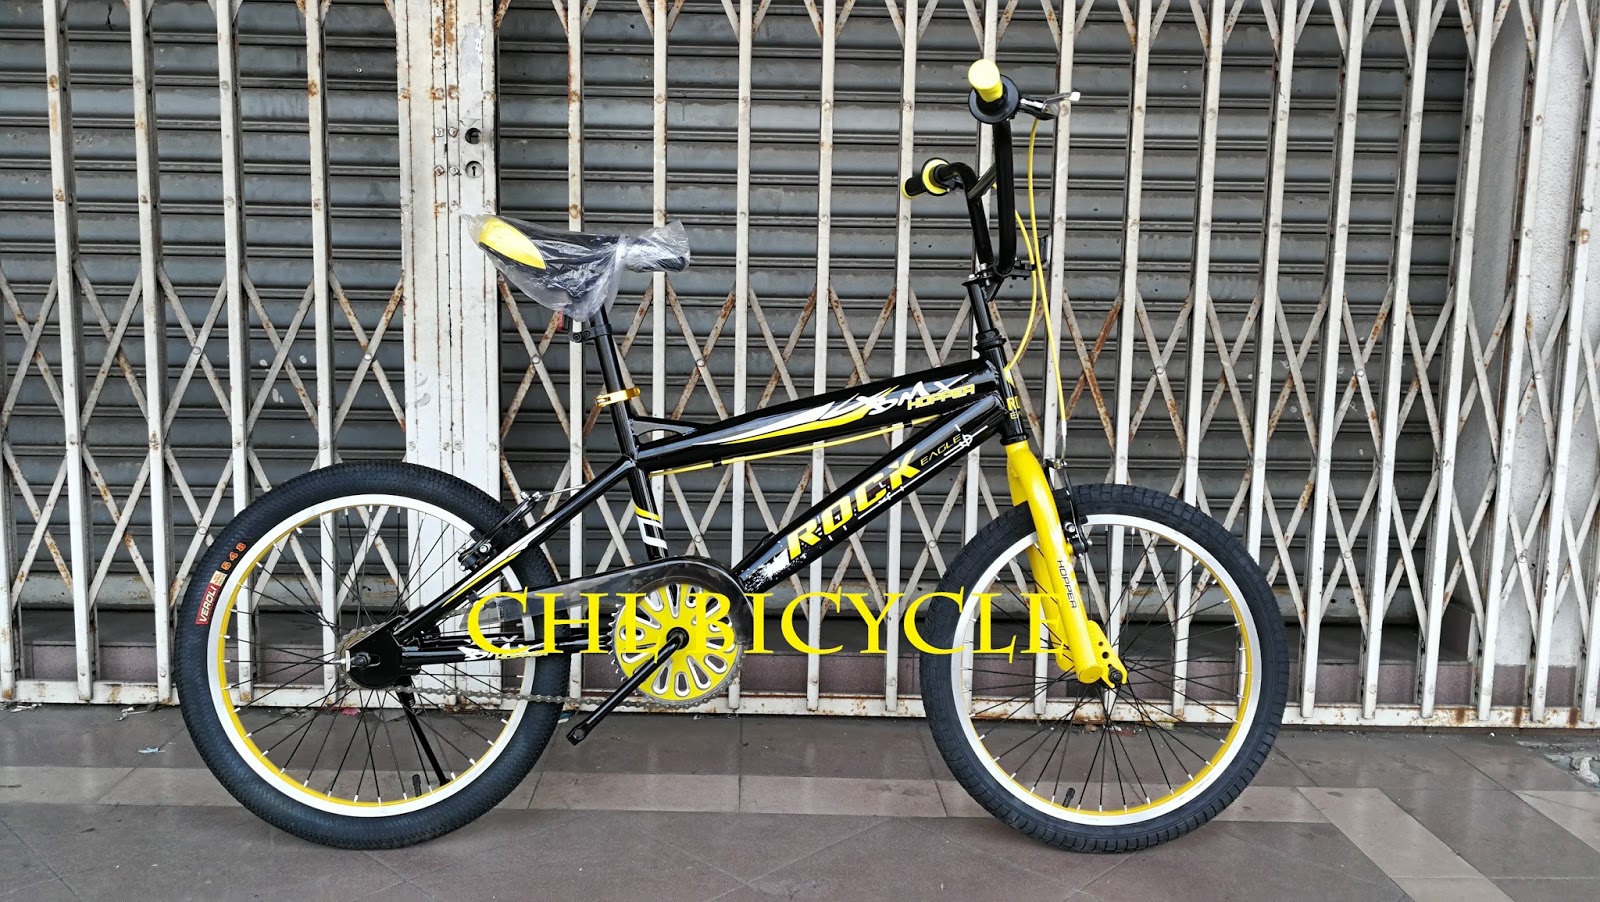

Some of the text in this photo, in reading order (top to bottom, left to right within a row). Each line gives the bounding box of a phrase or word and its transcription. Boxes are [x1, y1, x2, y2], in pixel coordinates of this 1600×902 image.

[907, 383, 976, 411] HOPPER
[786, 433, 962, 560] ROCK EAGLE
[199, 585, 218, 623] VEROLI
[1056, 560, 1077, 609] HOPPER
